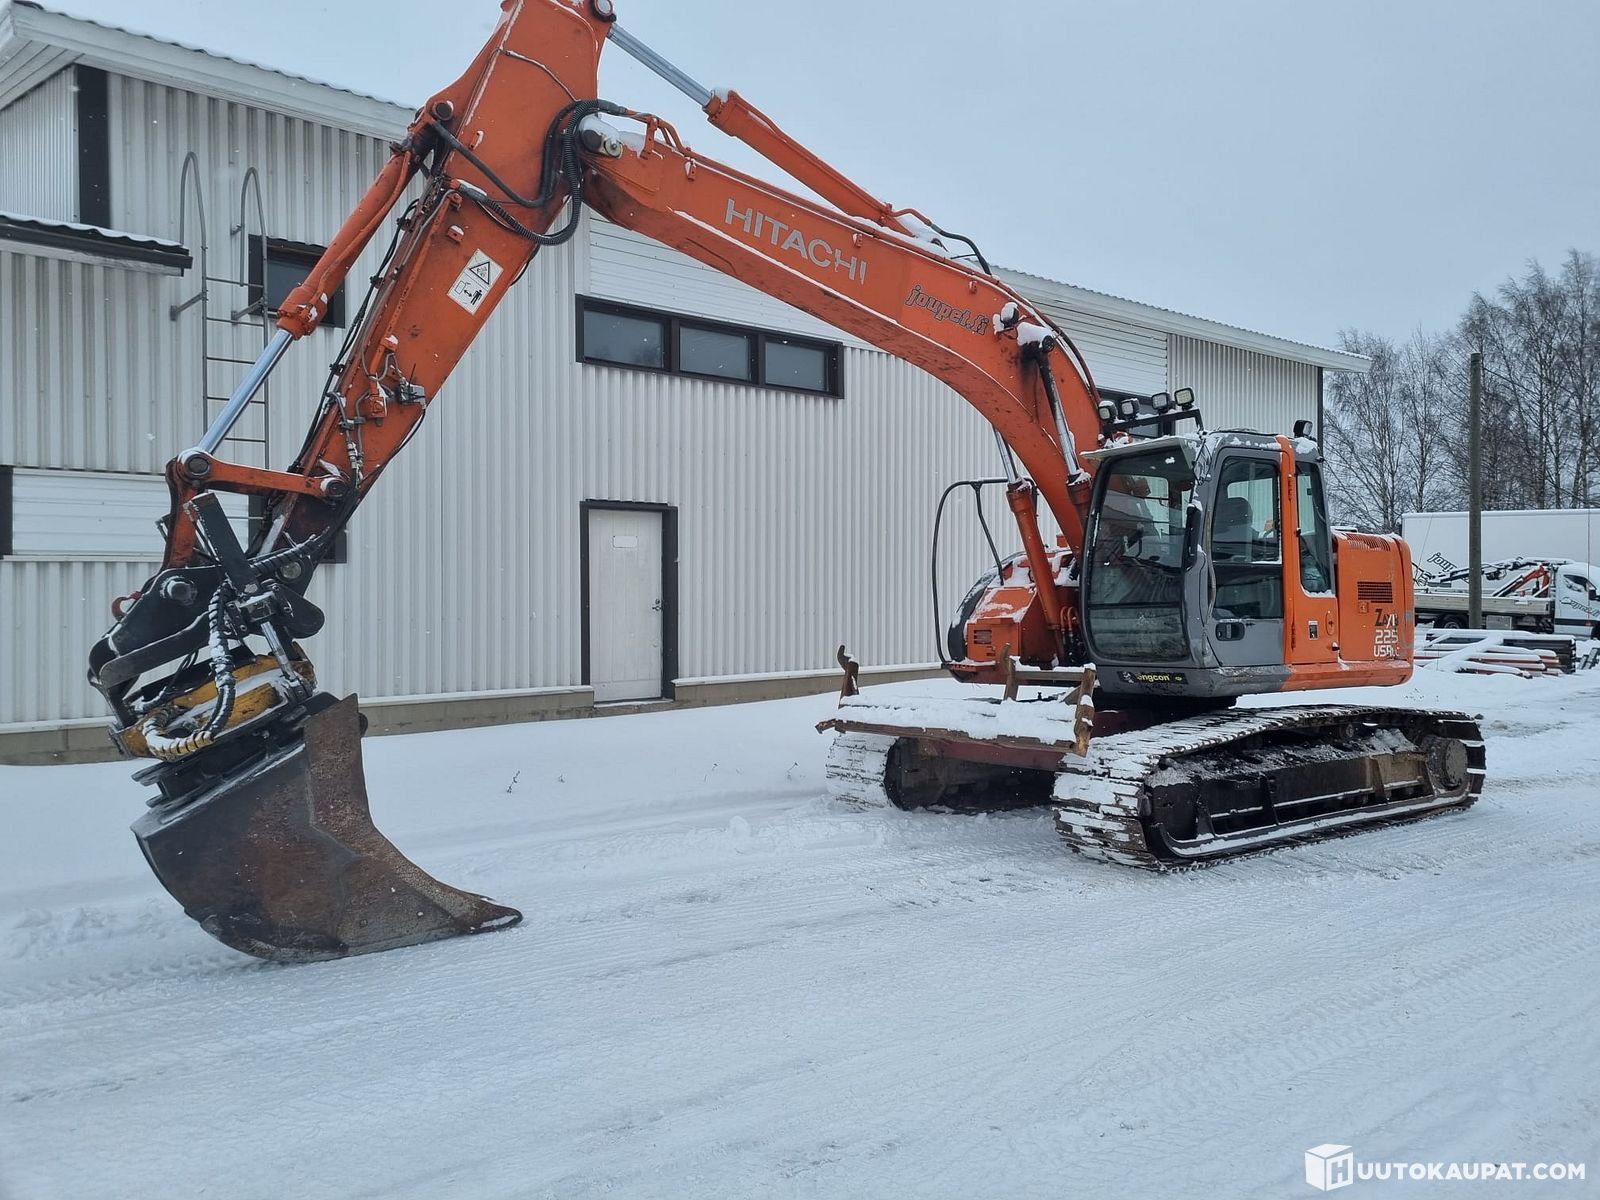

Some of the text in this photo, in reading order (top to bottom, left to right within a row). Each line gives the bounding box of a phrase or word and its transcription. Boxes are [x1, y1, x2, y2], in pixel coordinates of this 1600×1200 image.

[724, 197, 869, 285] HITACHI
[904, 284, 990, 336] joupet.fi
[1375, 629, 1399, 644] 225
